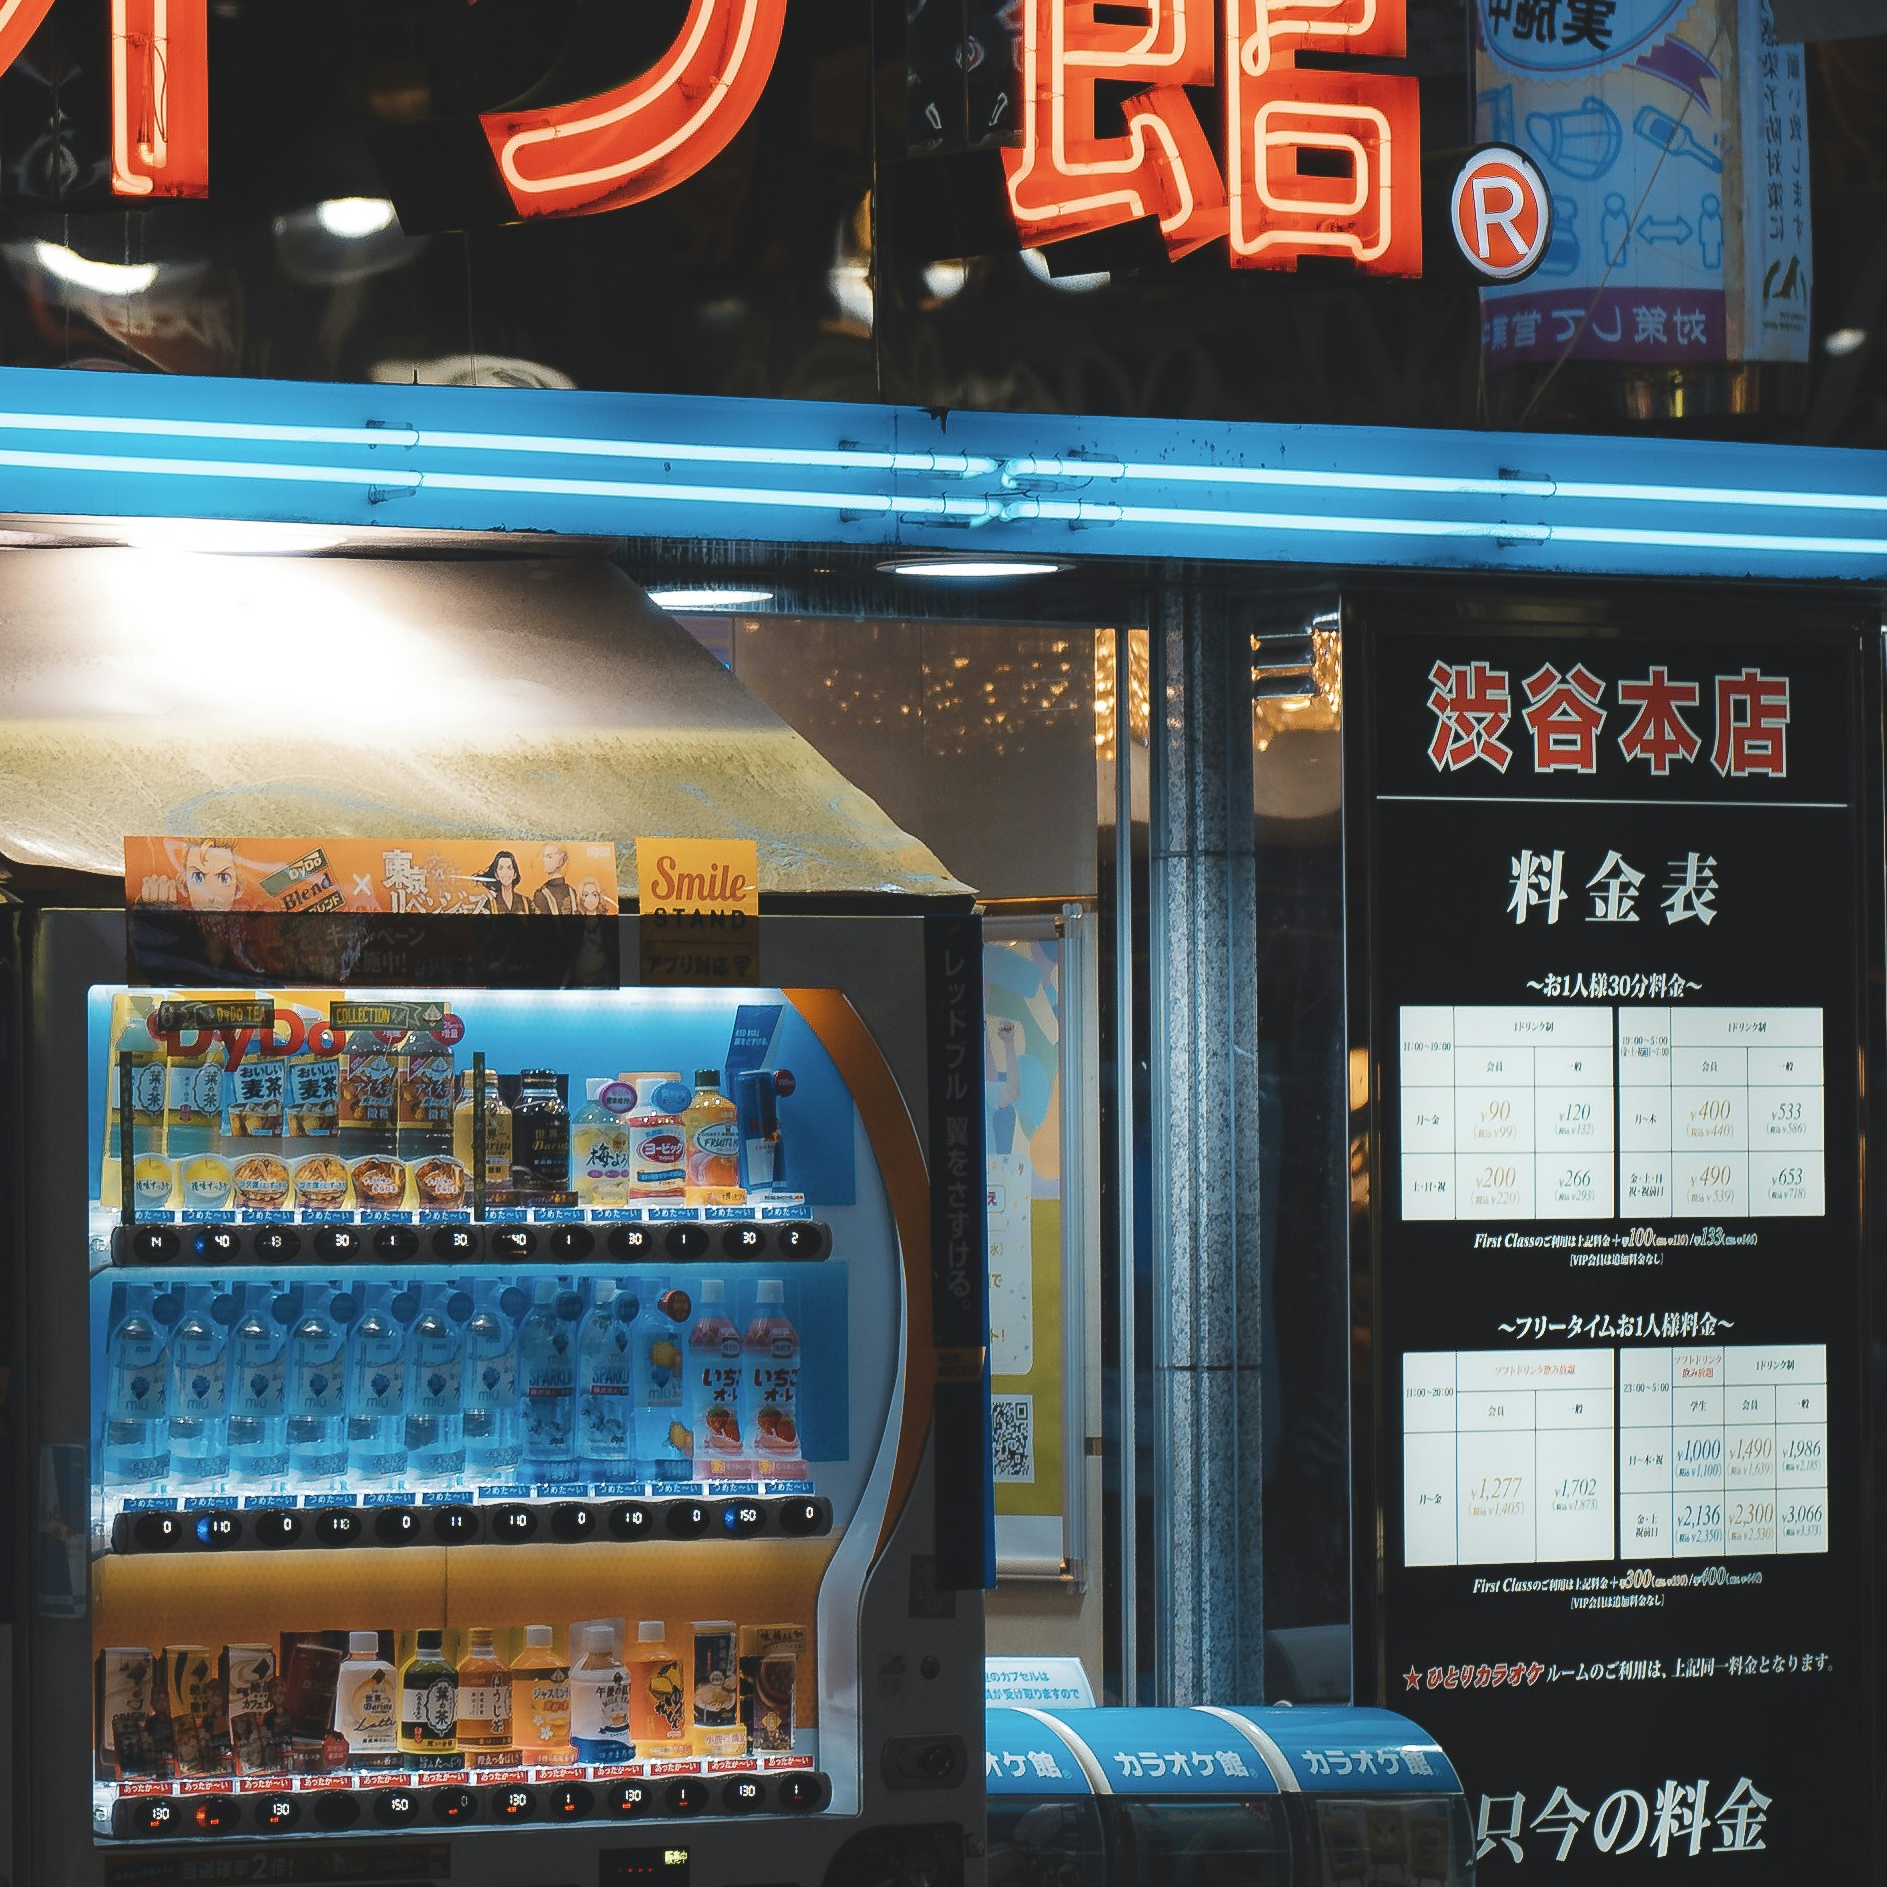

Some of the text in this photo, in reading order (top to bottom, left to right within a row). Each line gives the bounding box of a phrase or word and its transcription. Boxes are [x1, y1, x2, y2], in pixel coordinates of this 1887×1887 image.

[1426, 659, 1791, 778] 渋谷本店
[382, 849, 427, 894] 東京
[651, 856, 746, 901] Smile
[1506, 849, 1719, 926] 料金表
[653, 907, 746, 930] STAND
[336, 1007, 390, 1023] COLLECTION
[240, 1065, 283, 1078] おいしい
[241, 1080, 283, 1098] 麦茶
[298, 1080, 339, 1098] 麦茶
[1559, 1104, 1591, 1121] ¥120
[1690, 1100, 1731, 1121] ¥400
[1772, 1103, 1802, 1120] ¥533
[1475, 1167, 1516, 1188] ¥200
[1559, 1170, 1591, 1187] ¥266
[1691, 1166, 1731, 1186] ¥490
[1772, 1168, 1803, 1186] ¥653
[1677, 1439, 1721, 1463] ¥1,000
[1729, 1438, 1772, 1462] ¥1,490
[1782, 1440, 1821, 1459] ¥1,986
[1471, 1477, 1523, 1501] ¥1,277
[1554, 1478, 1597, 1498] ¥1,702
[1677, 1505, 1721, 1527] ¥2,136
[1729, 1503, 1774, 1527] ¥2,300
[1782, 1505, 1823, 1524] ¥3,066
[435, 1686, 449, 1725] 葉の茶
[490, 1674, 503, 1733] ほうじ茶
[1114, 1751, 1249, 1778] カラオケ館
[1302, 1750, 1433, 1776] カラオケ館
